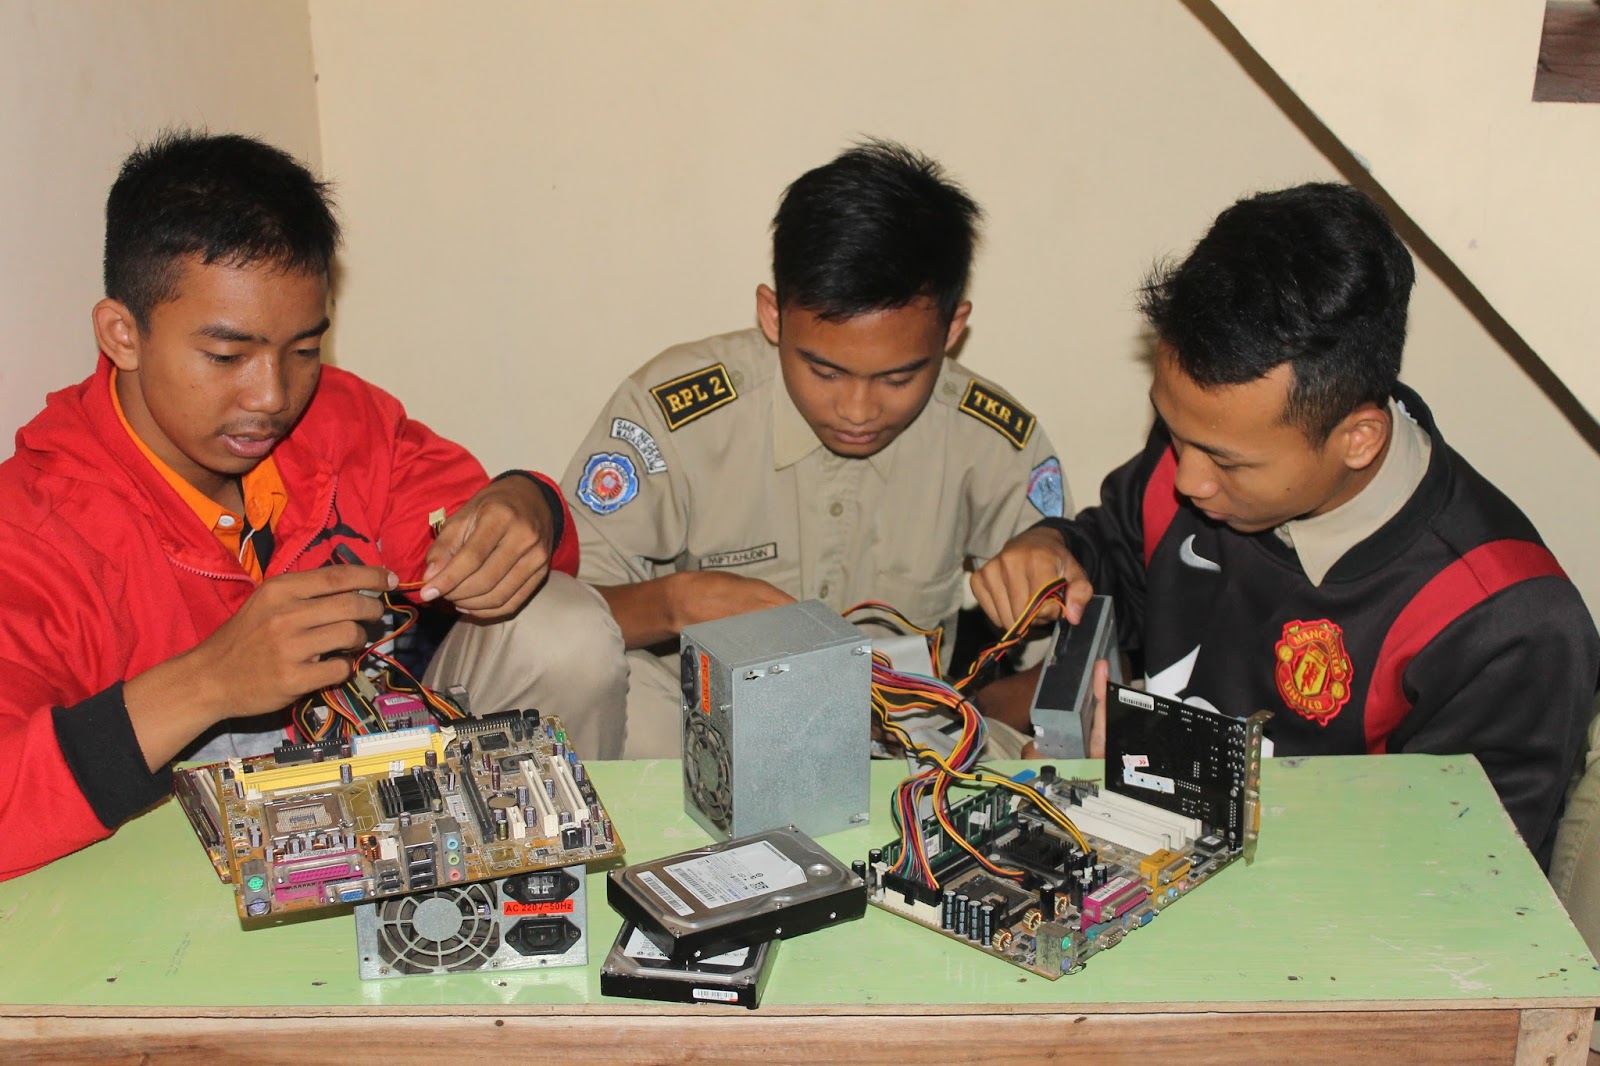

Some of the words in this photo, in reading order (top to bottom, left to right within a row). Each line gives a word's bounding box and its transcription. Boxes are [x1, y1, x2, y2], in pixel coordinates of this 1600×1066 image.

[666, 384, 709, 413] RPL
[709, 376, 726, 395] 2
[973, 391, 1012, 423] TKR
[1015, 417, 1024, 432] 1
[617, 420, 636, 433] SMK
[639, 432, 663, 461] NEGERI
[707, 547, 768, 565] MIFTAHUDIN
[1293, 629, 1342, 675] MANCHESTER
[1284, 680, 1323, 710] UNITED
[506, 905, 519, 913] AC
